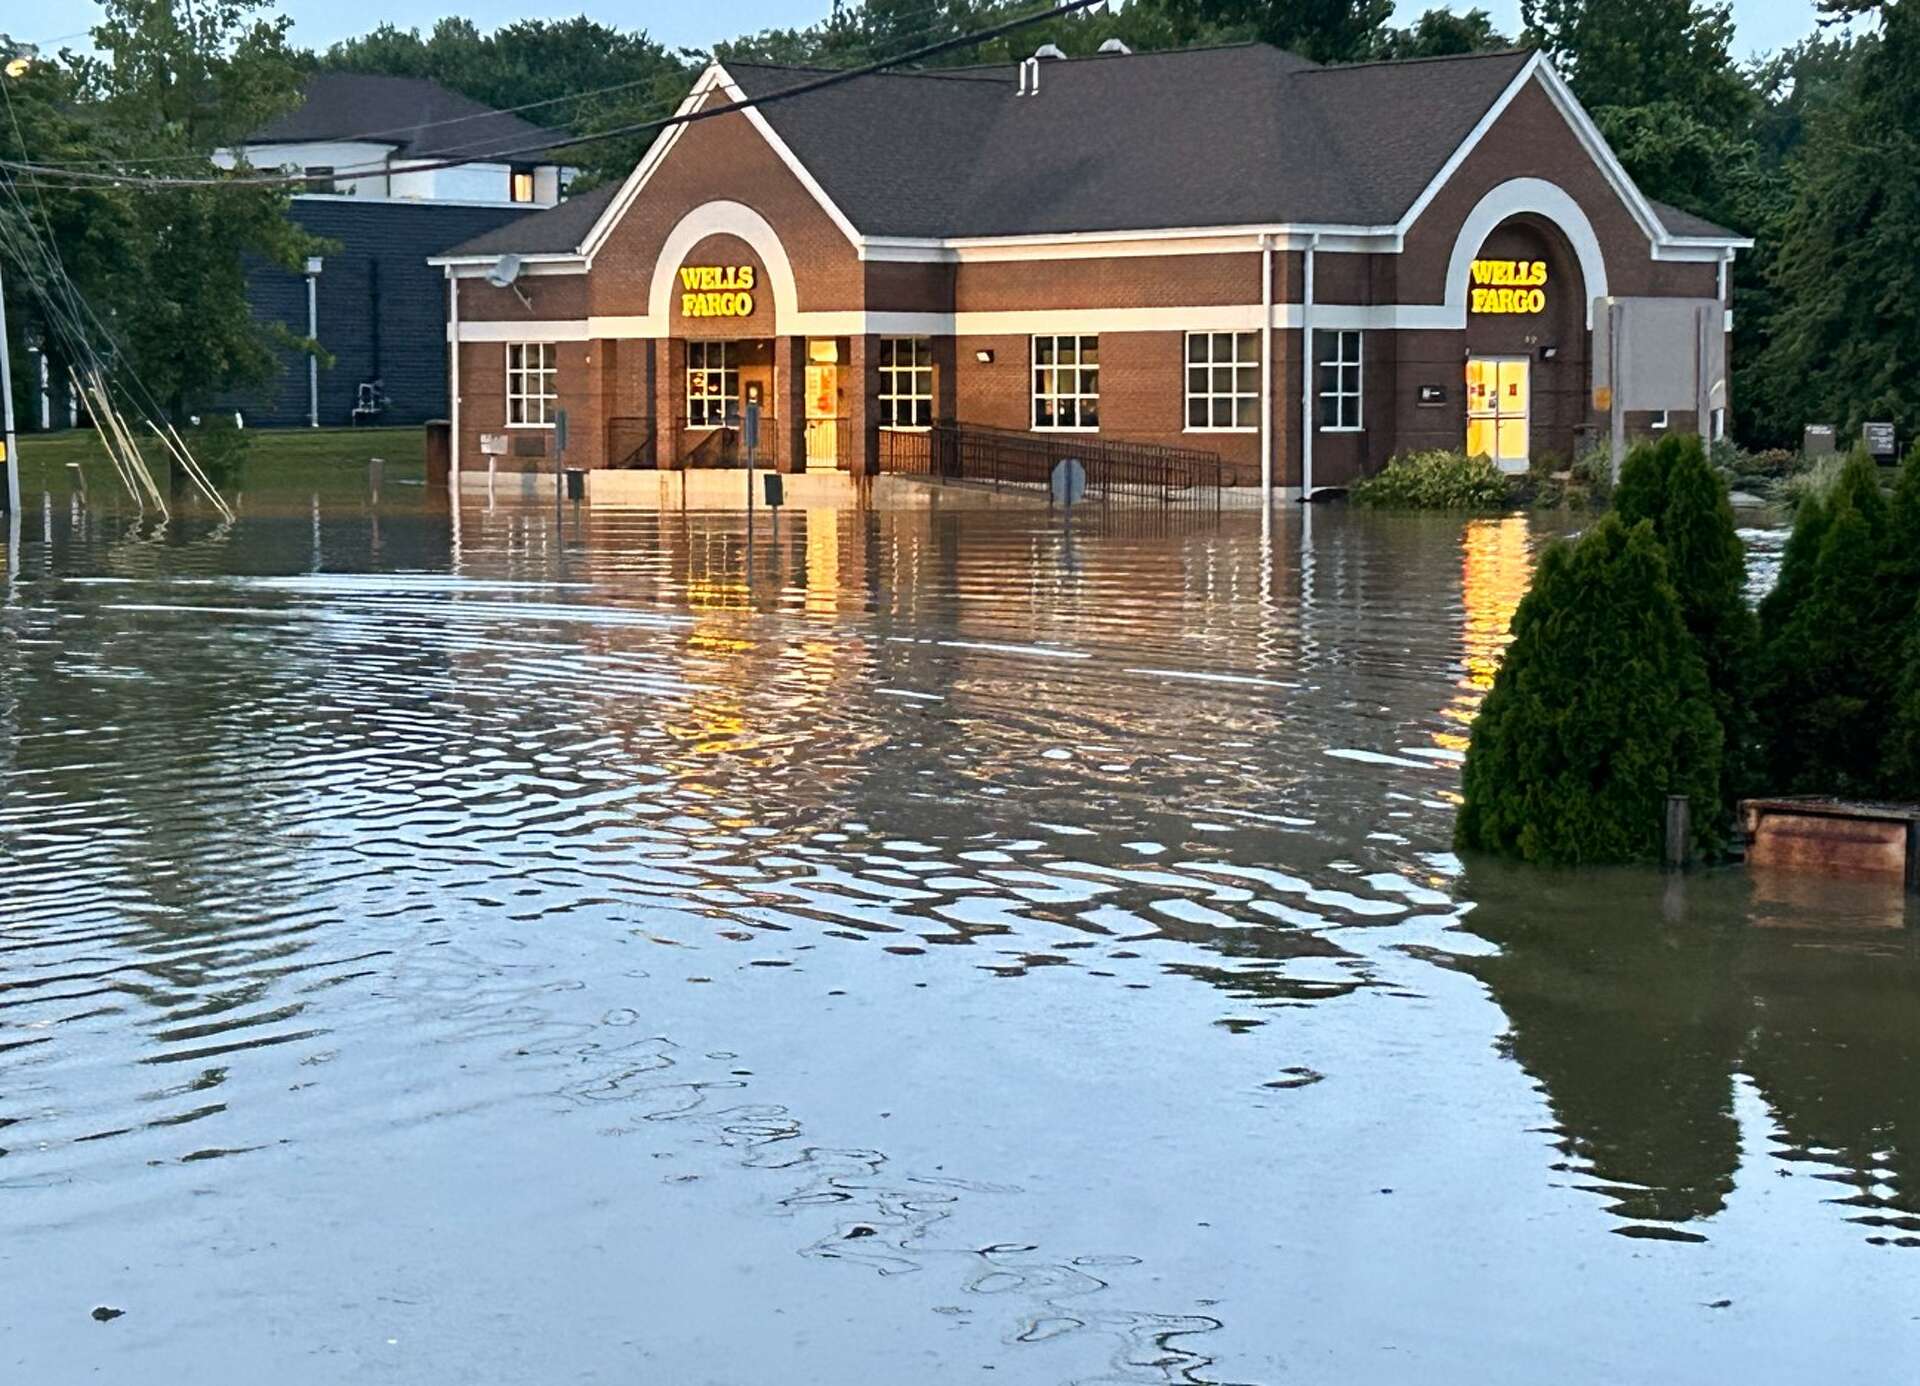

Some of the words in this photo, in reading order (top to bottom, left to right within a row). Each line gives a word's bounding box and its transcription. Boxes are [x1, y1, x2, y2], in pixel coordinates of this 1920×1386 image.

[680, 266, 754, 290] WELLS
[1471, 260, 1547, 286] WELLS
[682, 292, 752, 317] FARGO
[1471, 289, 1545, 313] FARGO
